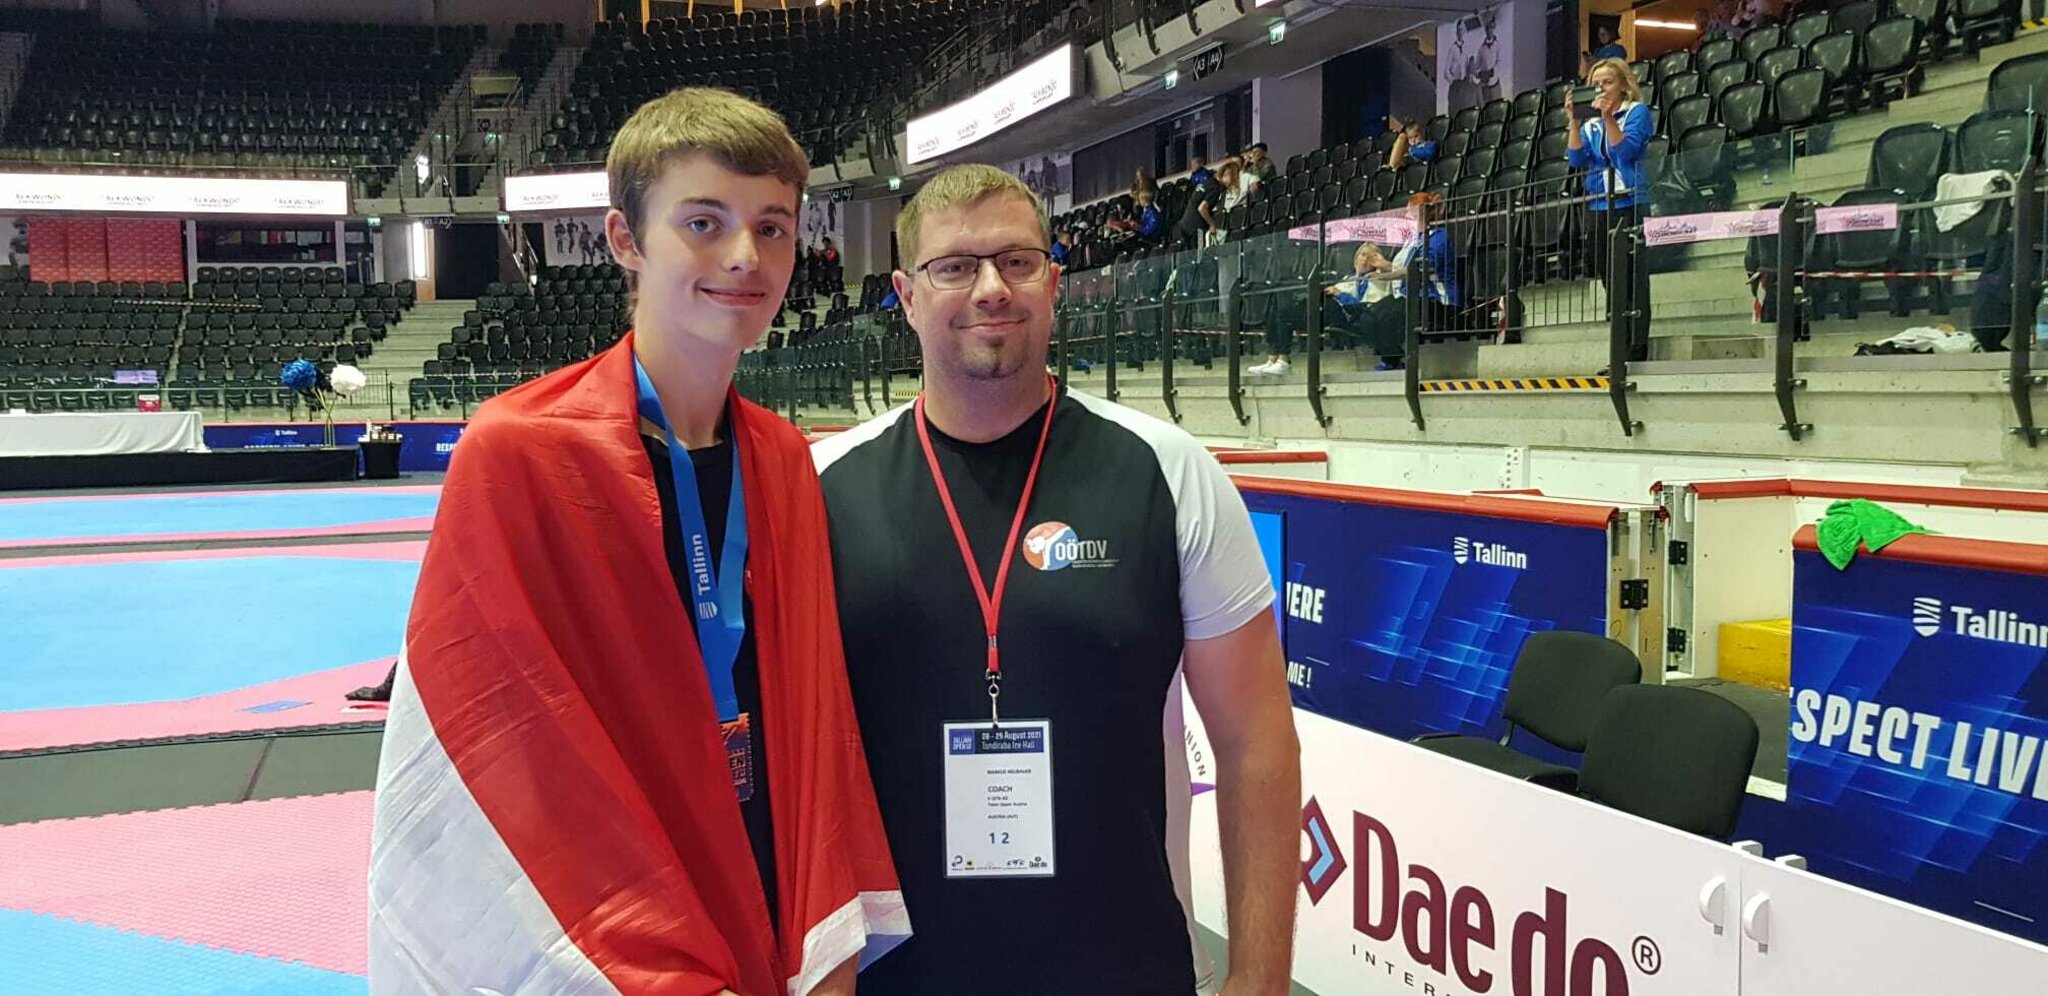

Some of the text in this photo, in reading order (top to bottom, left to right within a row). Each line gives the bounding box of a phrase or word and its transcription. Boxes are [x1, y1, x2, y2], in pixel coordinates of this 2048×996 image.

[693, 534, 711, 596] Tallinn
[1472, 541, 1528, 570] Tallinn
[1789, 686, 1941, 770] SPECT
[988, 785, 1012, 793] COACH
[1352, 943, 1451, 996] INTER
